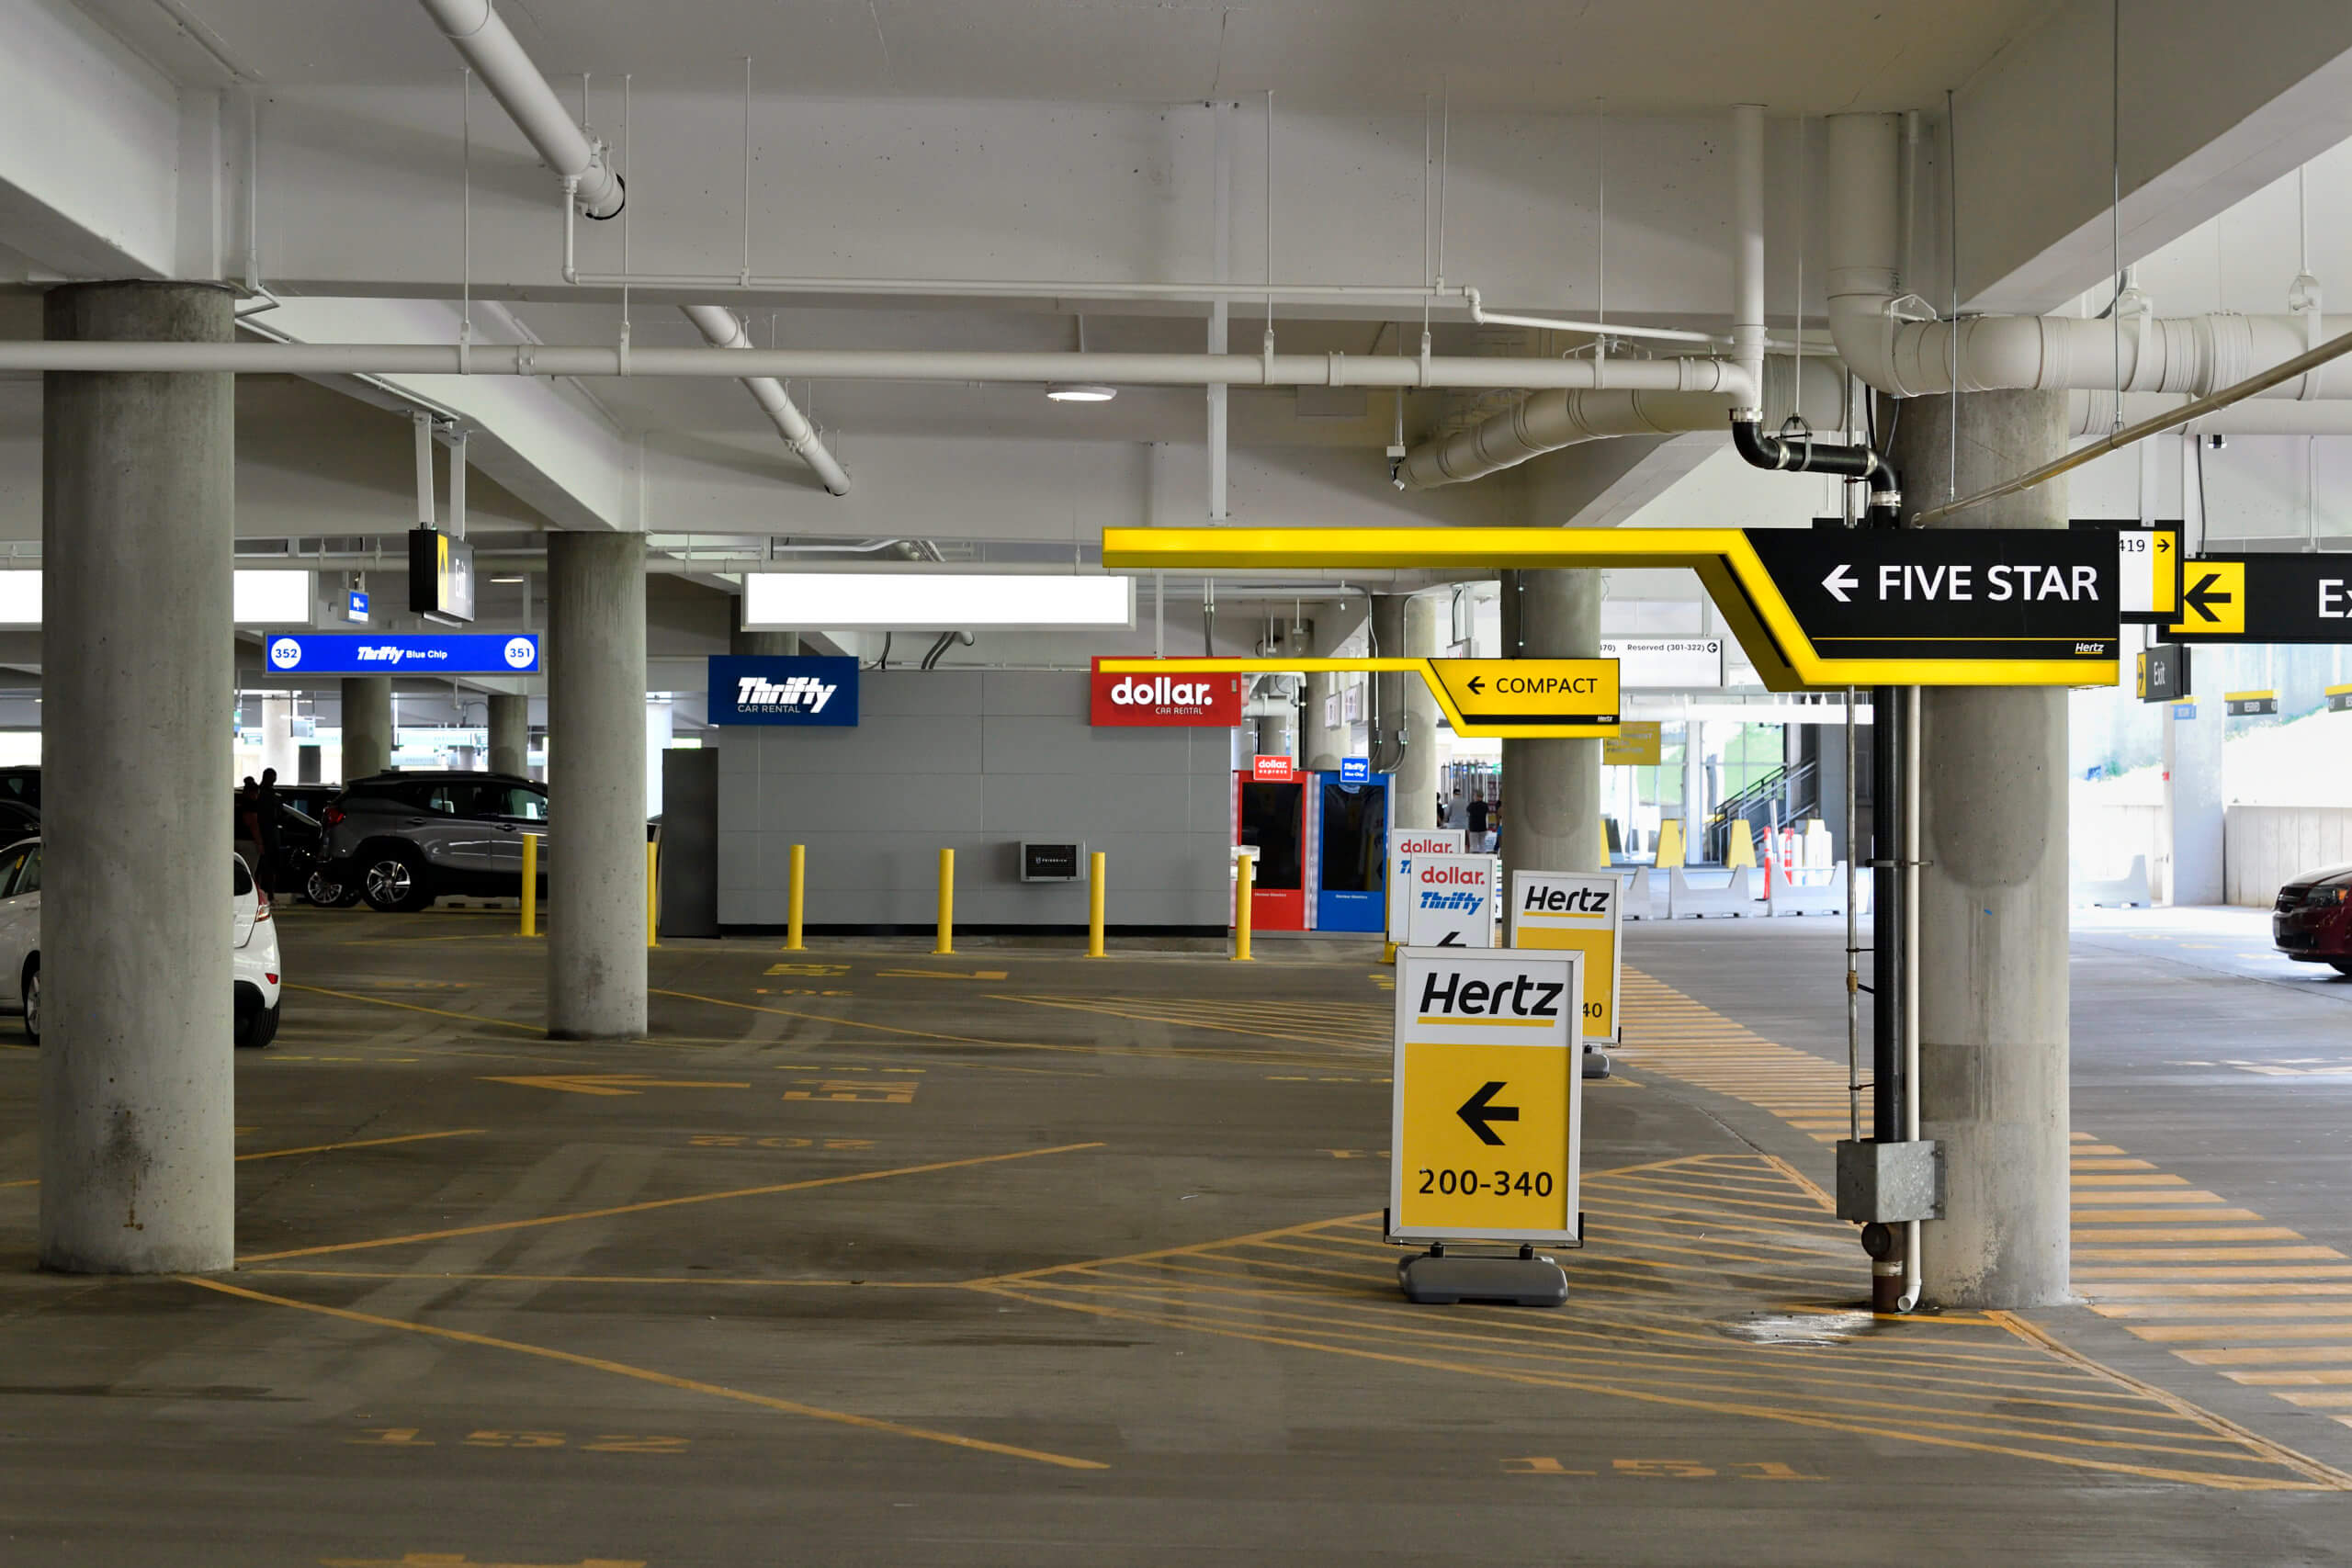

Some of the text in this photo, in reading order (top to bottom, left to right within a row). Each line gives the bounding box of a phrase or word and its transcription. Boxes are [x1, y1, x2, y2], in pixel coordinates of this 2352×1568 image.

[1879, 565, 2099, 602] FIVE STAR
[2318, 579, 2352, 617] E
[275, 649, 298, 659] 352
[357, 646, 448, 664] Thrifty Blue Chip
[509, 648, 531, 659] 351
[1627, 643, 1664, 651] Reserved
[1667, 643, 1705, 652] (301-322)
[2075, 642, 2105, 653] Hertz
[2154, 661, 2166, 685] Exit
[737, 676, 838, 714] Thrifty
[1111, 676, 1213, 705] dollar.
[1496, 677, 1598, 694] COMPACT
[737, 705, 801, 713] CAR RENTAL
[1155, 706, 1204, 715] CAR RENTAL
[1400, 839, 1453, 853] dollar.
[1420, 866, 1486, 885] dollar.
[1420, 891, 1485, 916] Thrifty
[1524, 886, 1611, 912] Hertz
[1419, 972, 1565, 1016] Hertz
[1419, 1168, 1553, 1197] 200-340
[342, 1427, 693, 1453] 152
[1499, 1457, 1831, 1481] 151
